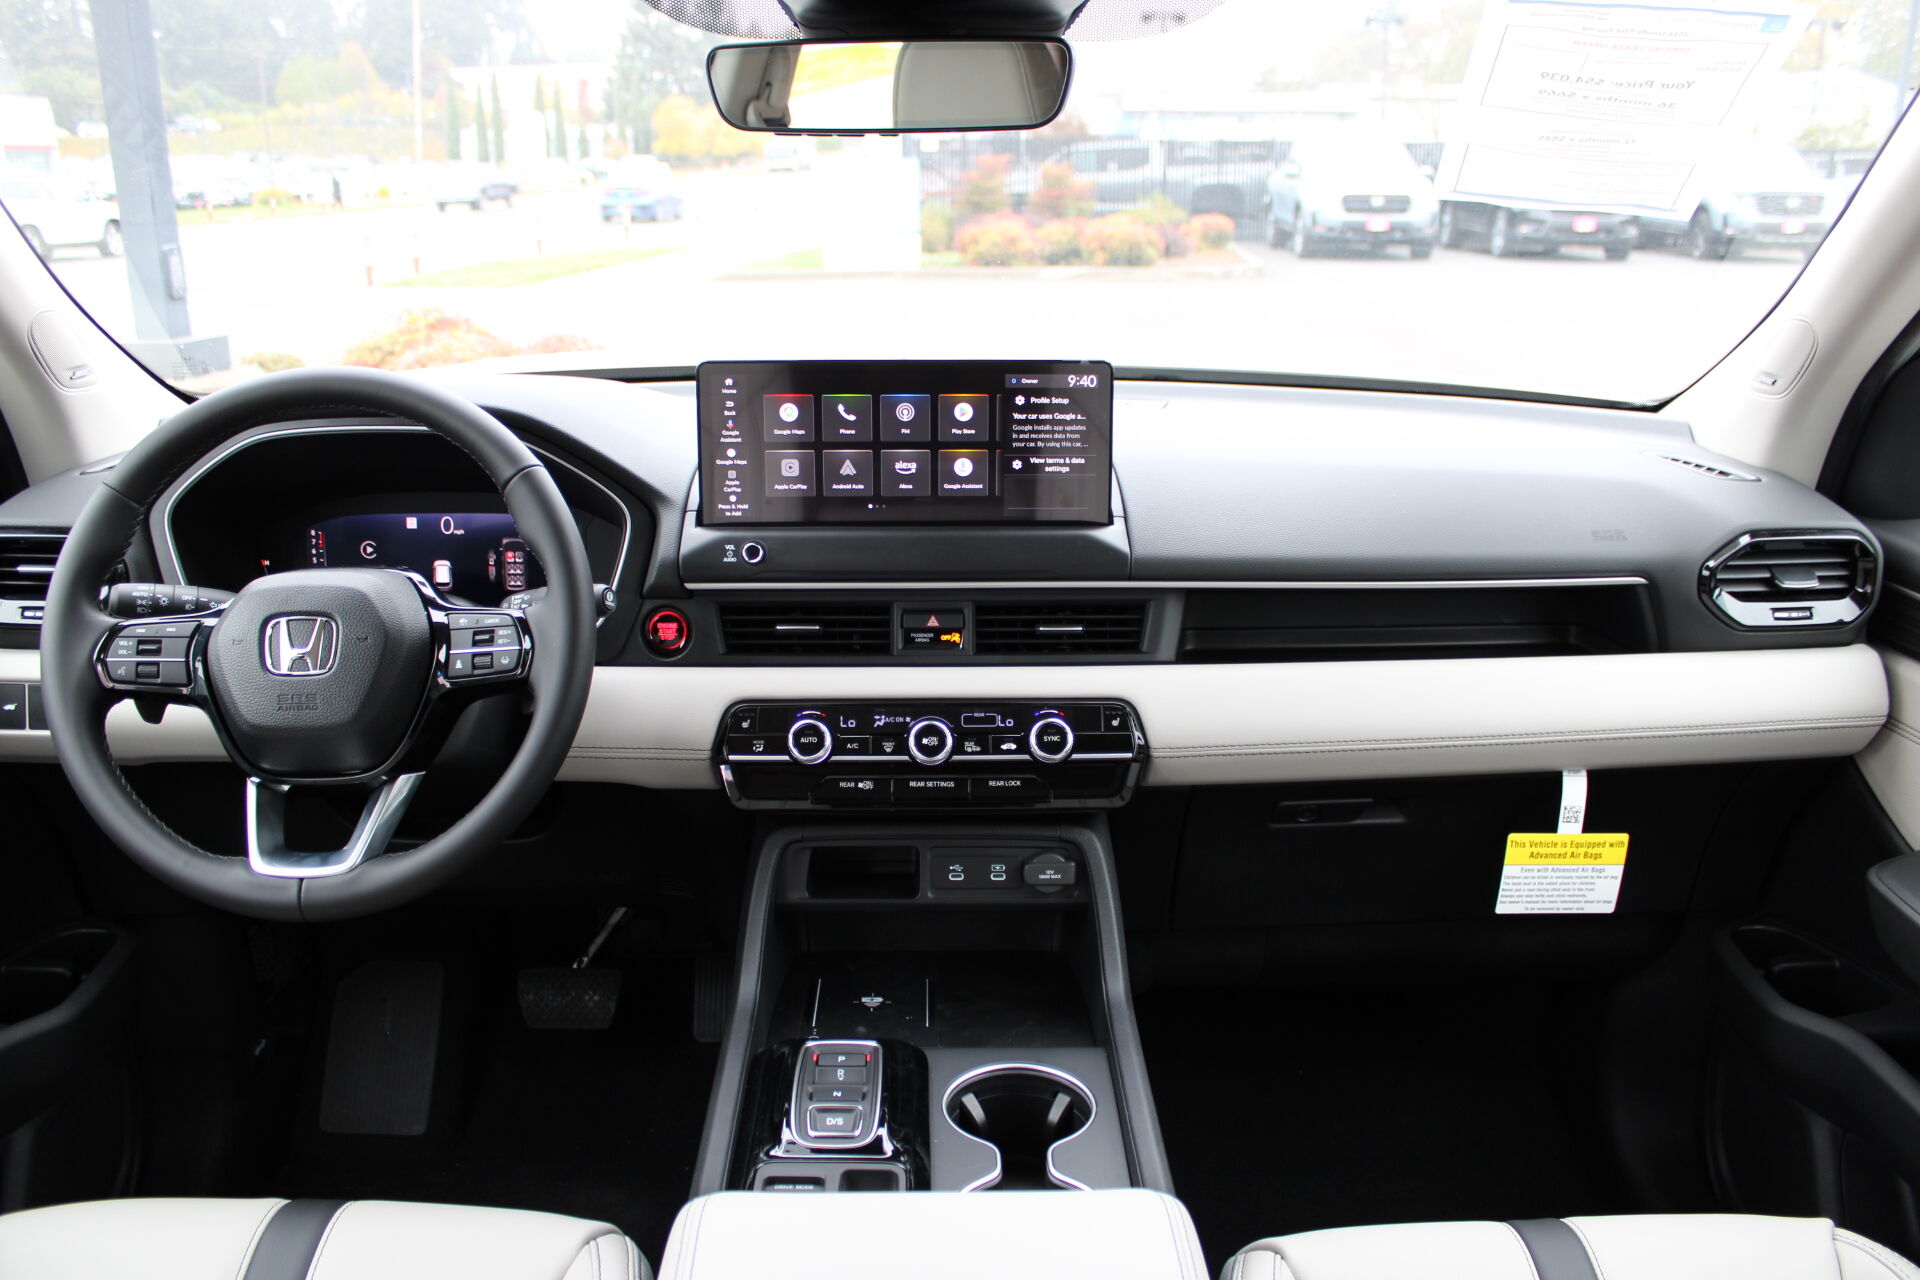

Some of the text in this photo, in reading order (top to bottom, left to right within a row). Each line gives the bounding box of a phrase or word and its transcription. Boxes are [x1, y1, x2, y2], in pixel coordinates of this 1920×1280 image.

[1067, 375, 1097, 388] 9:40
[1051, 397, 1070, 405] Setup
[1012, 412, 1027, 420] Your
[1053, 413, 1076, 421] Google
[895, 461, 917, 469] alexa
[440, 516, 454, 534] 0
[840, 716, 856, 728] Lo
[998, 715, 1014, 727] Lo
[1510, 840, 1625, 850] This Vehicle is Equipped with
[1529, 851, 1603, 860] Advanced Air Bags
[826, 1117, 844, 1126] D/S
